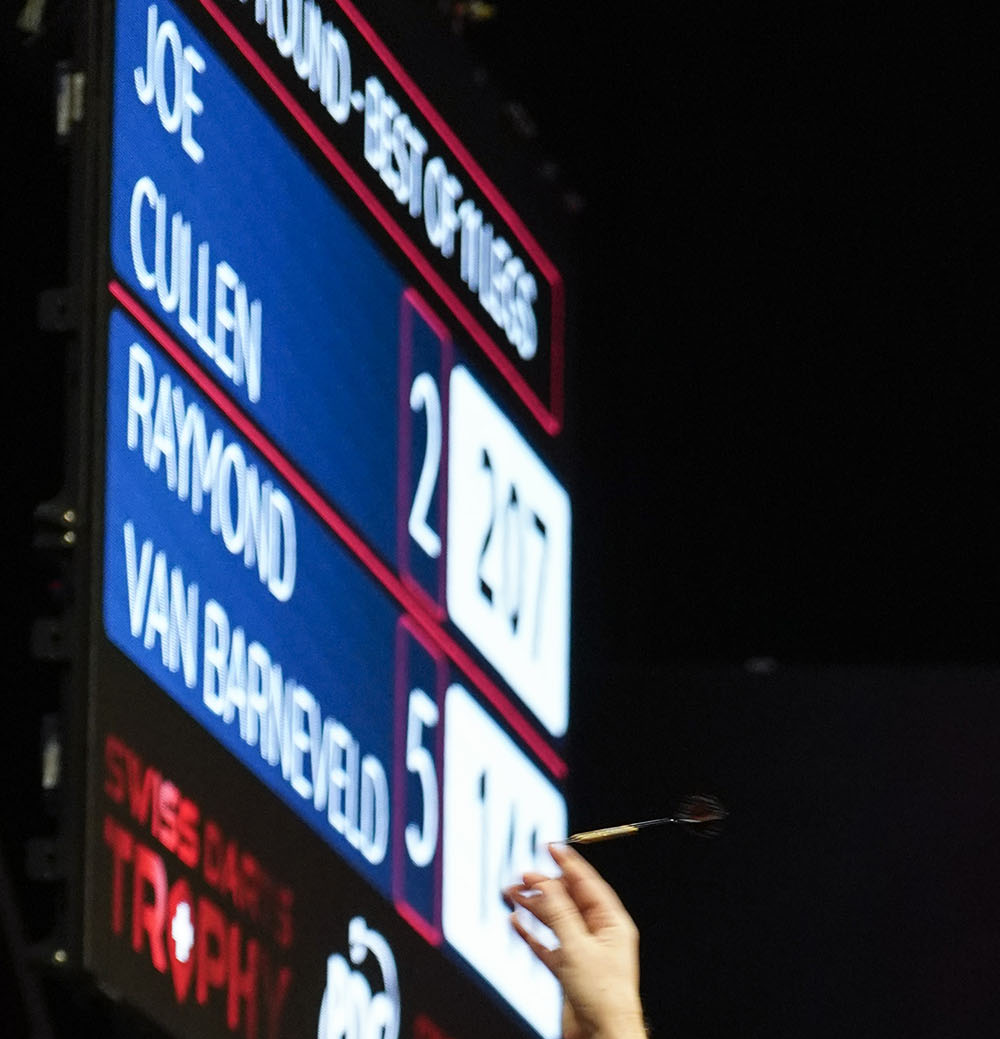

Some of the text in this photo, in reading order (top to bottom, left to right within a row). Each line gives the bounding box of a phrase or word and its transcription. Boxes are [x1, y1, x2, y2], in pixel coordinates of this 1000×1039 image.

[133, 4, 205, 164] JOE
[129, 176, 263, 403] CULLEN
[364, 76, 428, 218] BEST
[423, 157, 463, 258] OF
[478, 223, 538, 361] LEGS
[126, 342, 297, 602] RAYMOND
[408, 372, 548, 663] 2 207
[123, 520, 390, 865] VAN BARNEVELD
[404, 688, 440, 868] 5
[104, 733, 294, 949] SWISS DARS
